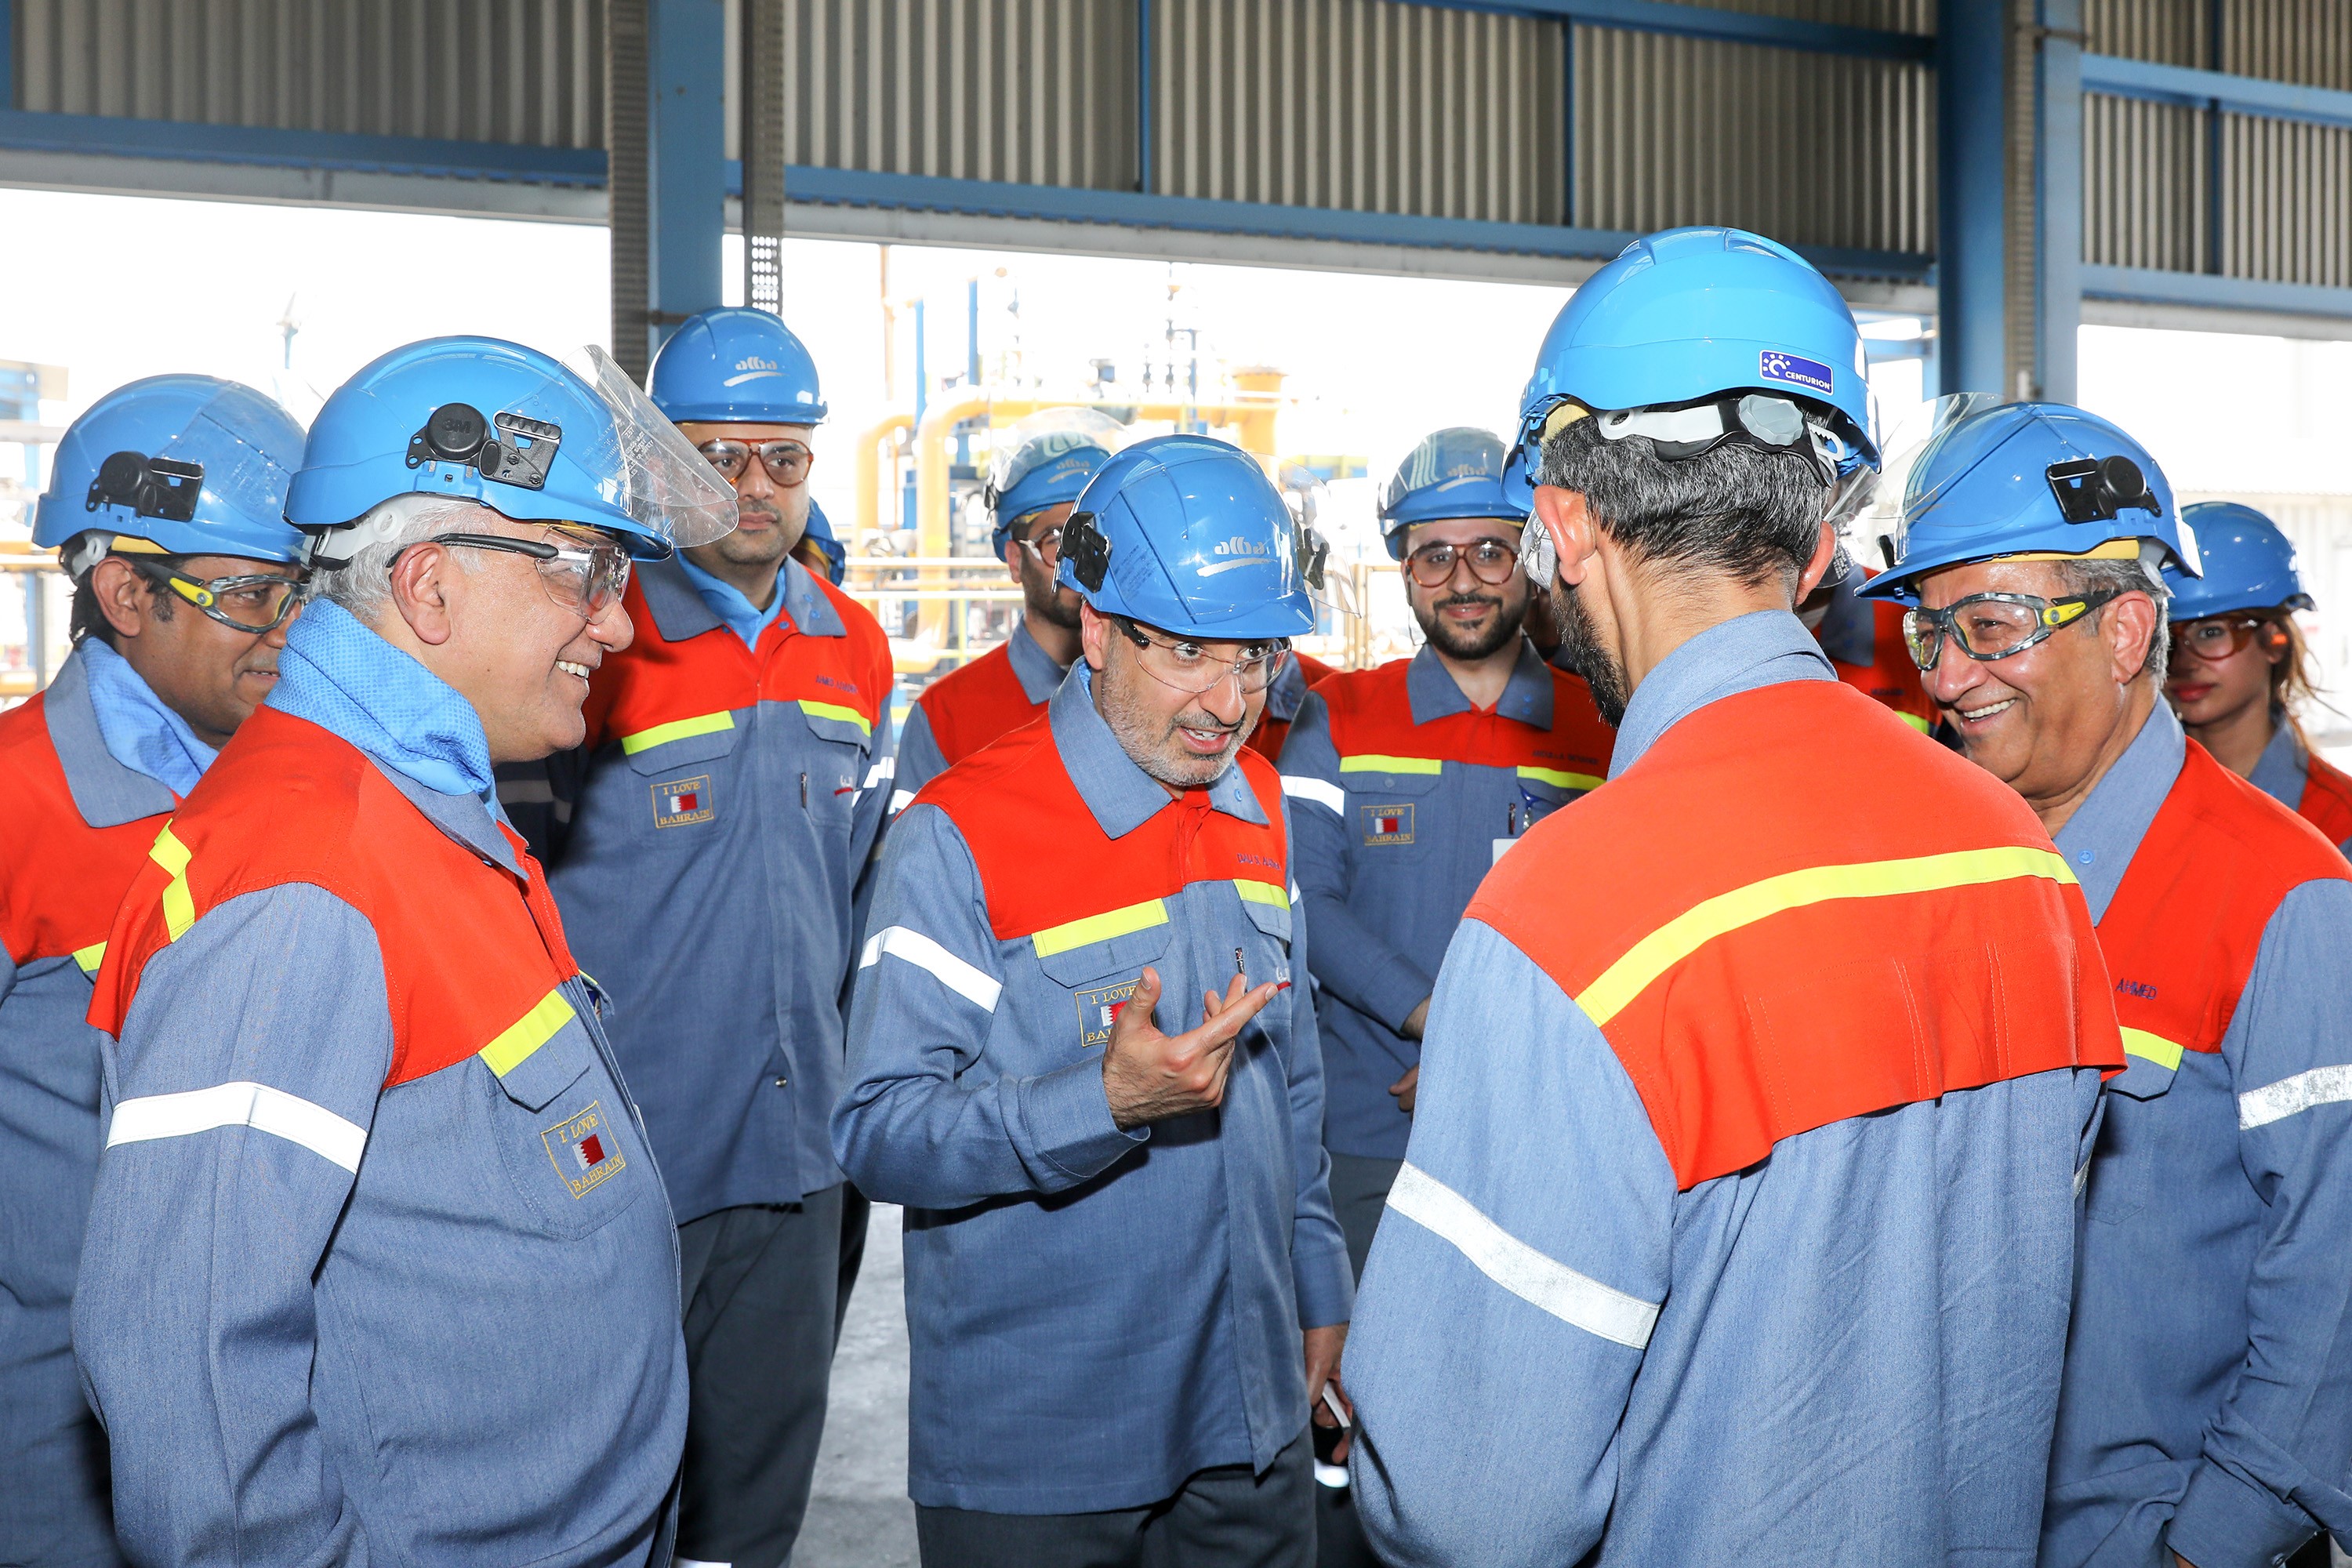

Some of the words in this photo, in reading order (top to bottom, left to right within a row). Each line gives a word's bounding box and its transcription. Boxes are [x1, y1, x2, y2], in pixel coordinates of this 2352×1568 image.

[1785, 371, 1831, 390] CENTURION
[442, 419, 471, 434] 3M
[663, 786, 669, 796] I
[673, 781, 701, 794] LOVE
[659, 809, 710, 825] BAHRAIN
[1378, 808, 1405, 817] LOVE
[1366, 833, 1411, 843] BAHRAIN
[2115, 978, 2158, 1000] AHMED
[1091, 994, 1098, 1005] I
[559, 1130, 568, 1143] I
[570, 1113, 598, 1138] LOVE
[571, 1154, 623, 1192] BAHRAIN
